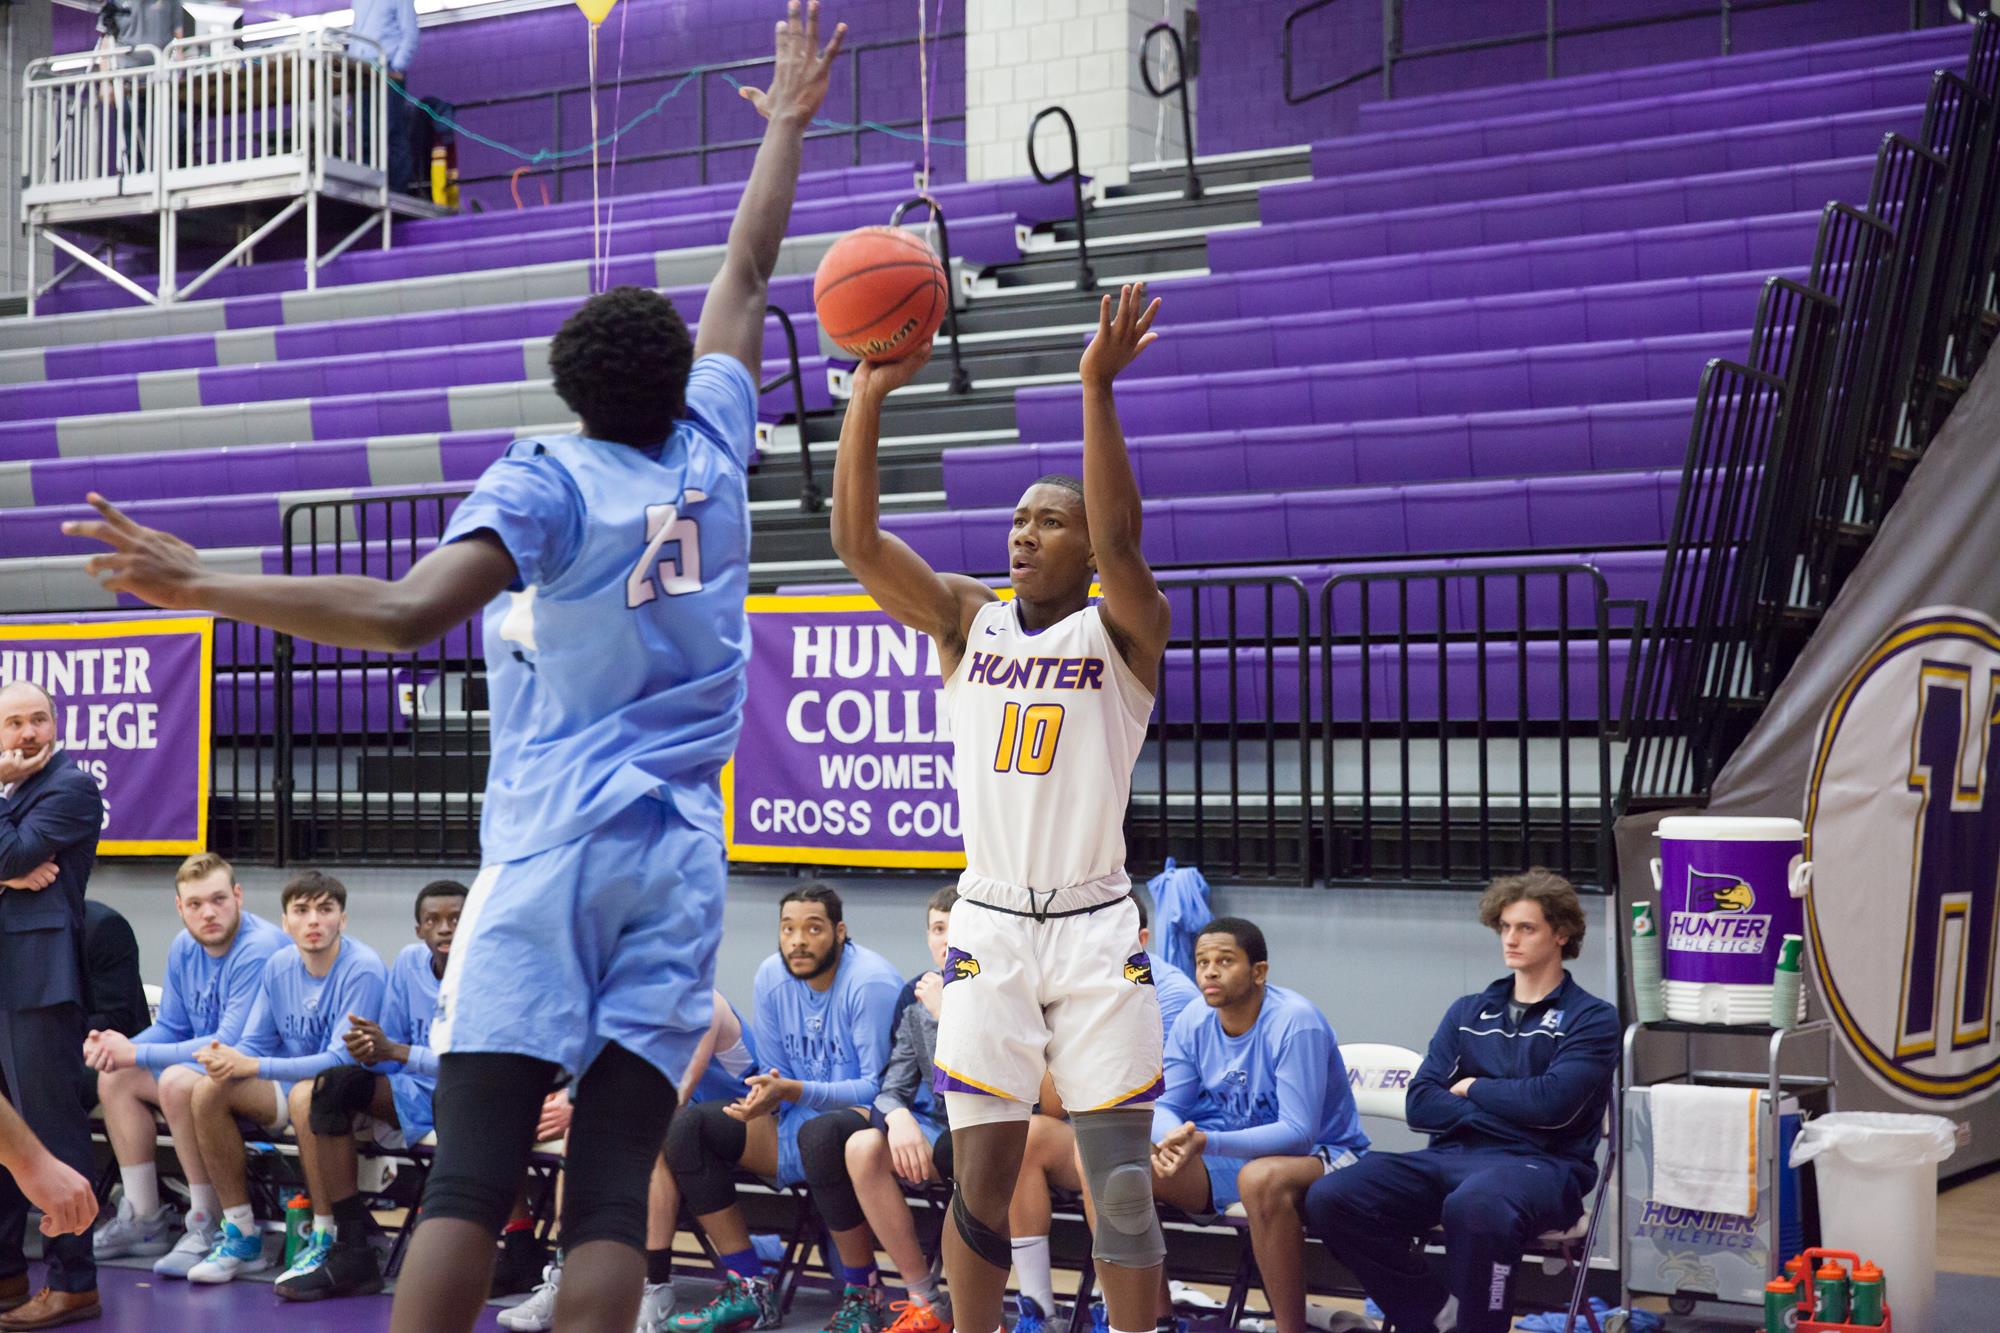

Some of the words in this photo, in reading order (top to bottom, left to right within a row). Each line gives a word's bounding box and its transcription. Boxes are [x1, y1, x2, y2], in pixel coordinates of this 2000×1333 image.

[790, 624, 944, 679] HUNT
[967, 650, 1105, 690] HUNTER
[54, 702, 159, 750] LEGE
[786, 690, 954, 744] COLL
[993, 701, 1065, 776] 10
[819, 755, 959, 790] WOMEN
[750, 798, 872, 836] CROSS
[1668, 938, 1762, 953] ATHLETICS
[1672, 916, 1766, 938] HUNTER
[1348, 1068, 1411, 1089] NTER
[1640, 1199, 1759, 1235] HUNTER
[1634, 1226, 1755, 1249] ATHLETICS
